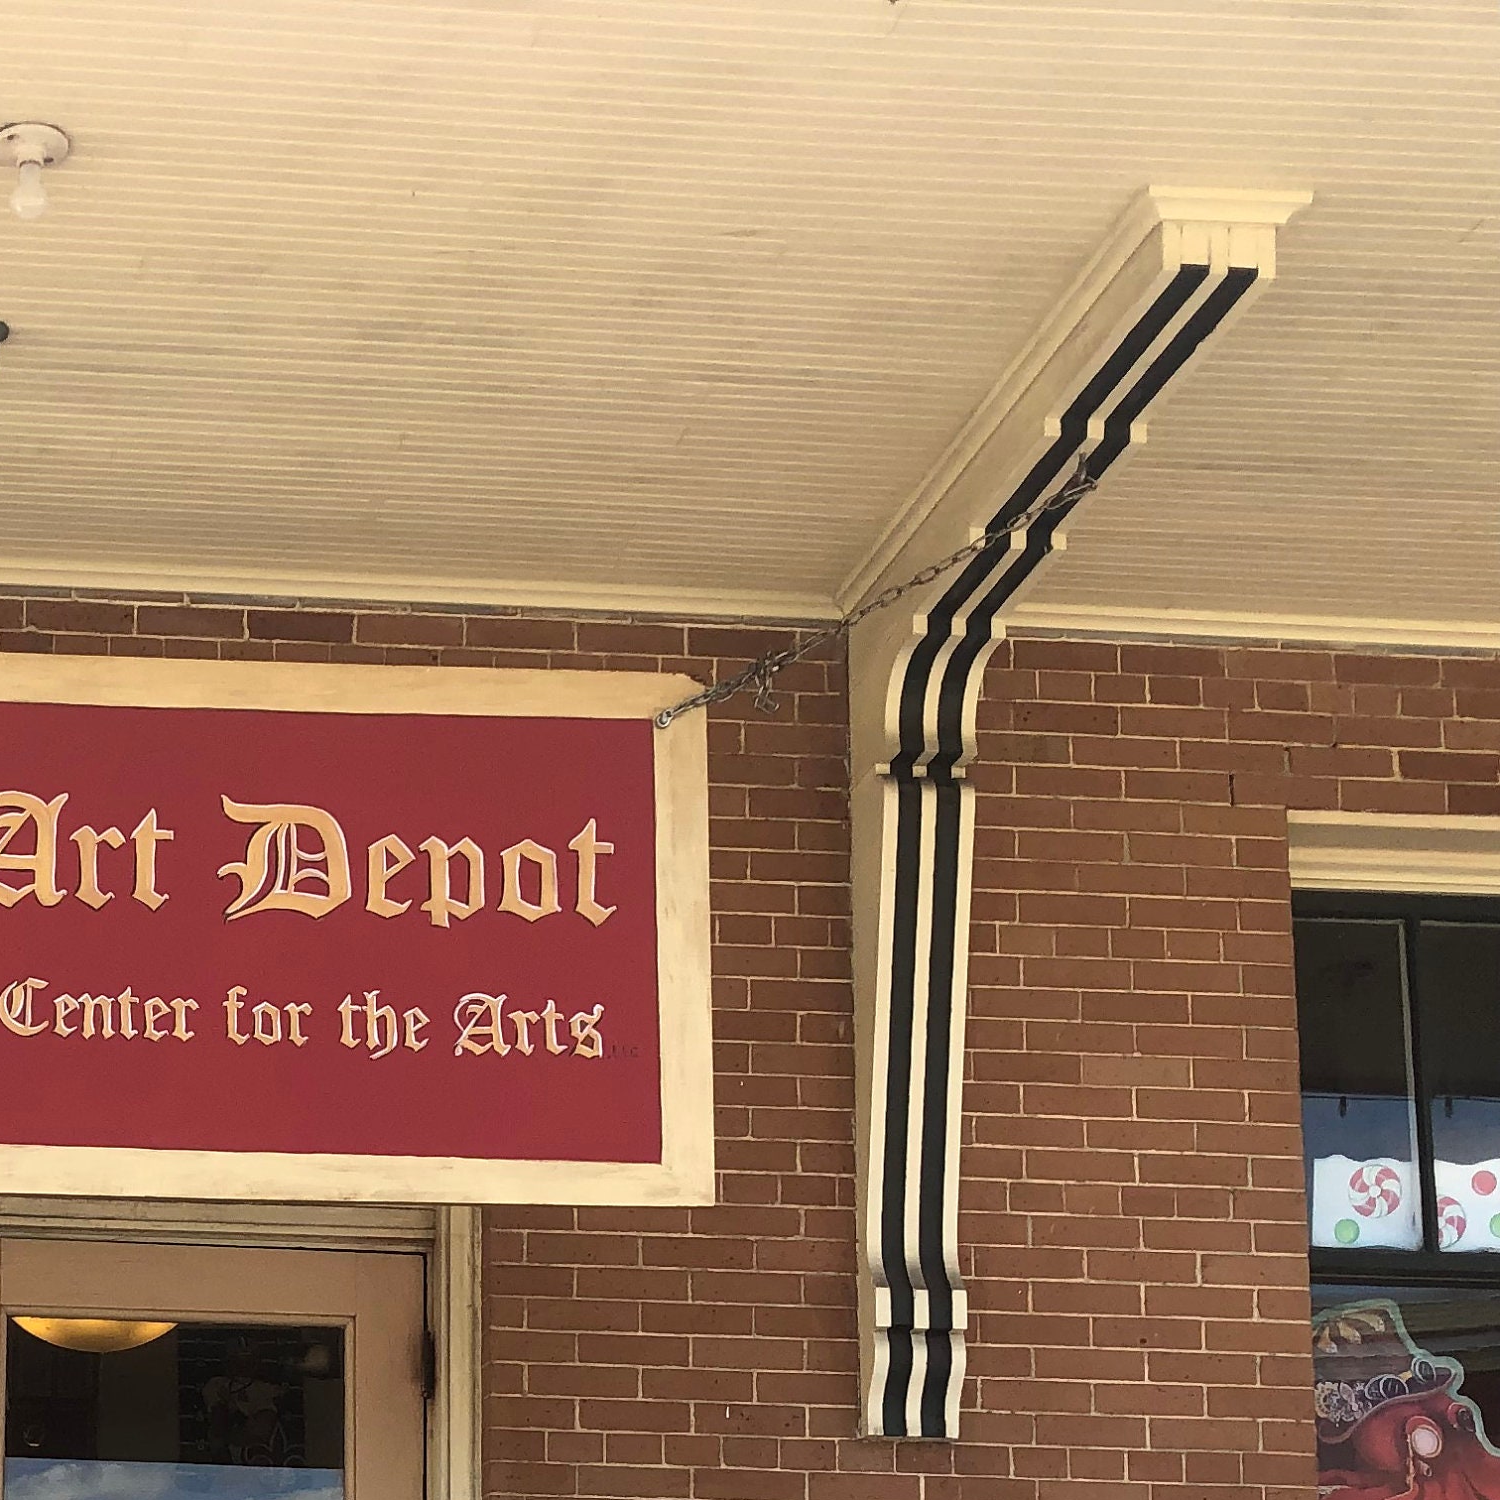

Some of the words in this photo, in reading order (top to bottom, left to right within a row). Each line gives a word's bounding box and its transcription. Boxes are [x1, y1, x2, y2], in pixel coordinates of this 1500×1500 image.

[217, 794, 617, 928] Depot
[223, 985, 313, 1045] for
[338, 990, 431, 1060] the
[454, 992, 604, 1058] Arts
